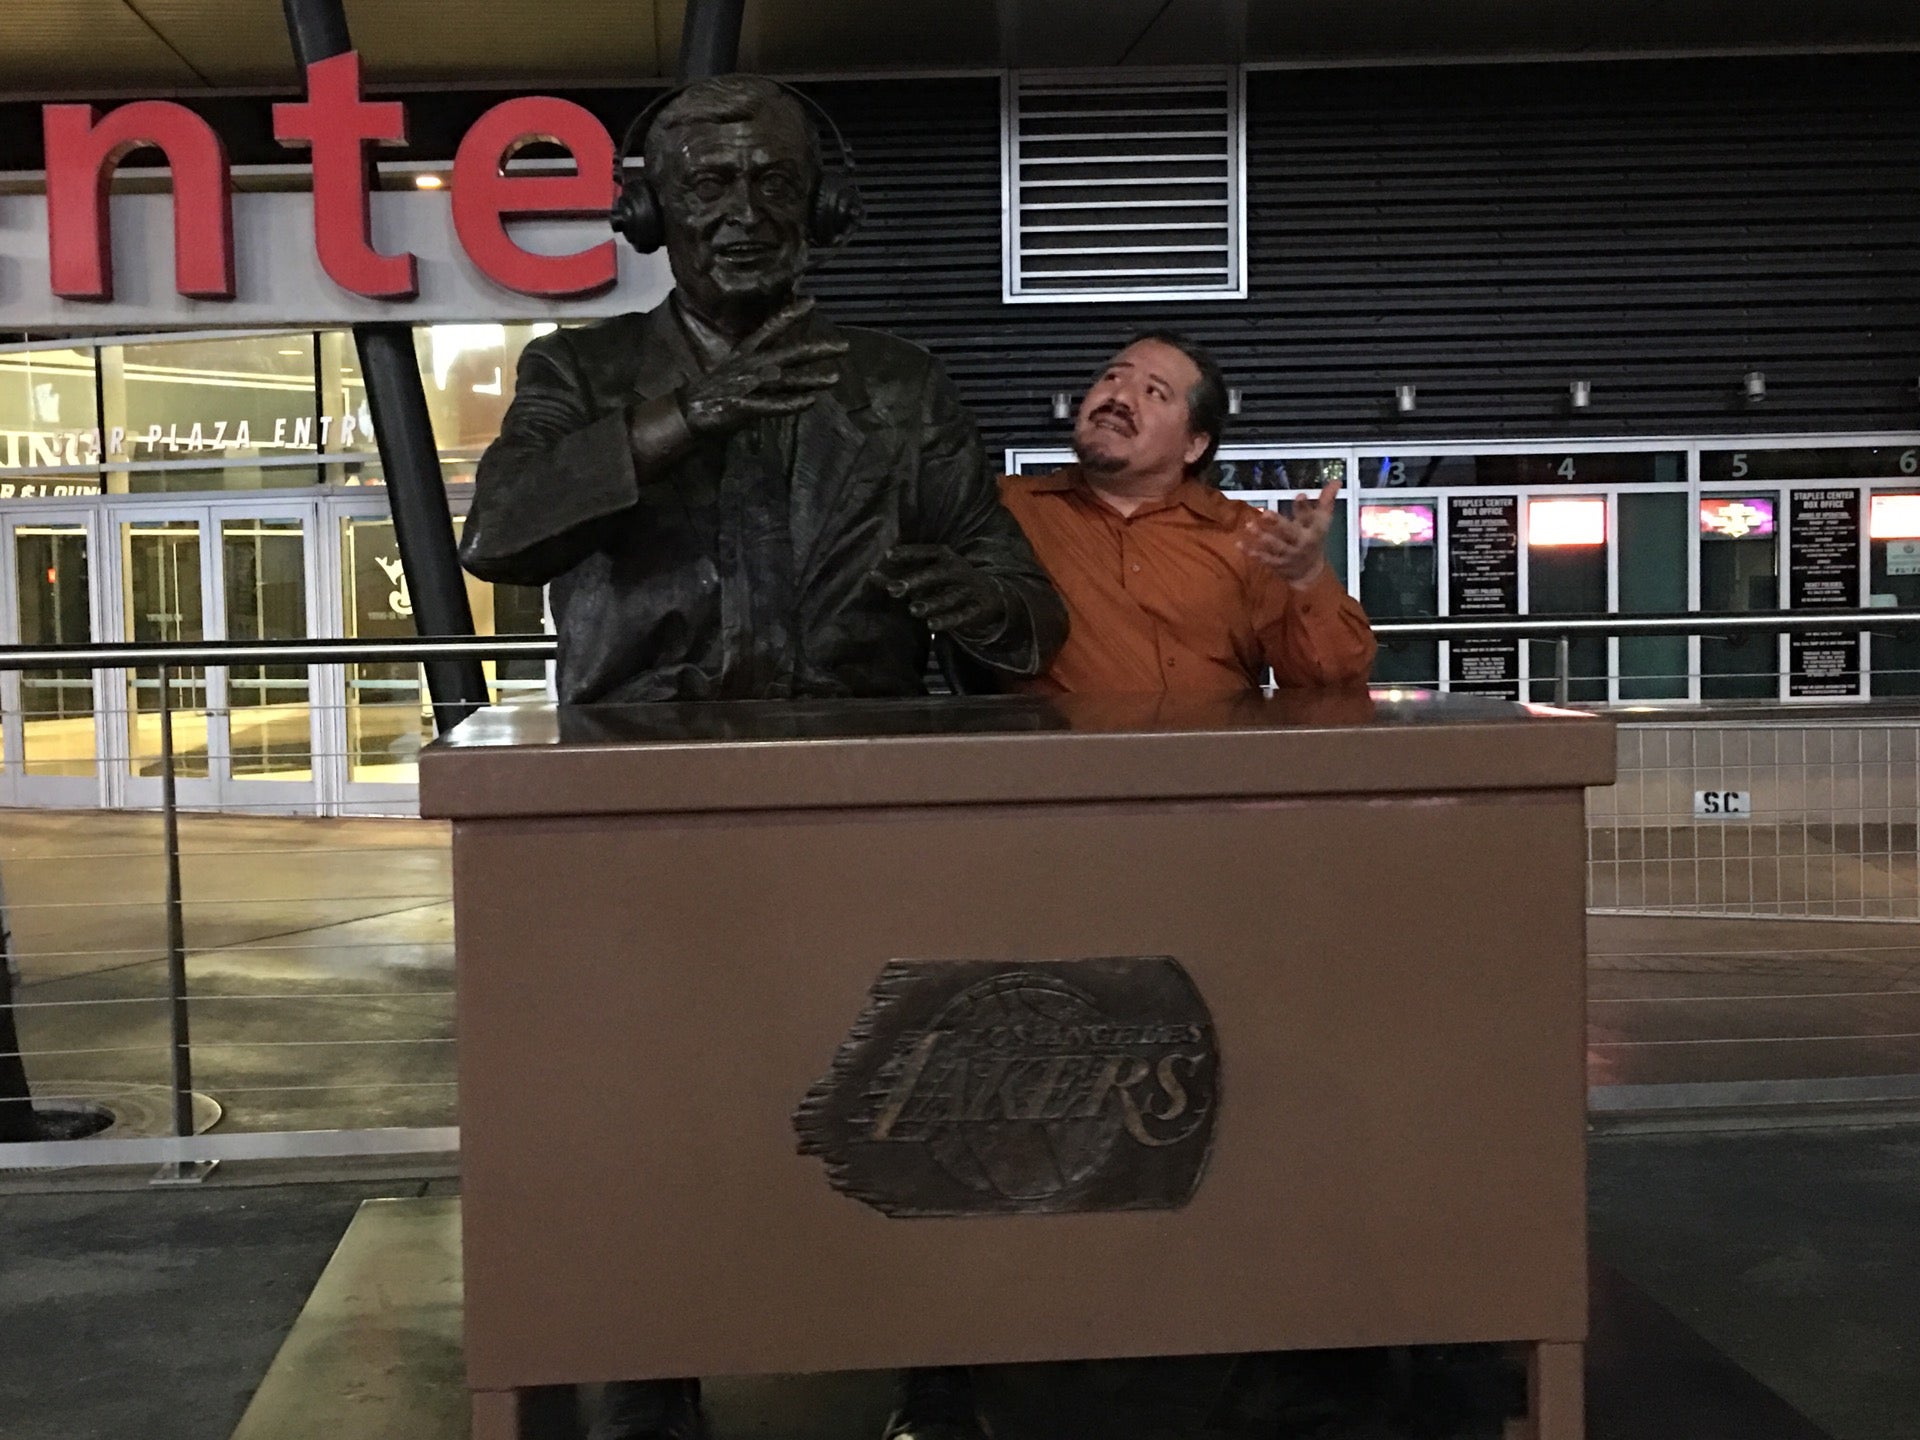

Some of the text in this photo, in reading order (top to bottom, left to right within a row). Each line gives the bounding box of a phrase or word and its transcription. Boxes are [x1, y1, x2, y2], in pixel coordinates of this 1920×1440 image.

[147, 420, 251, 453] PLAZA
[273, 415, 374, 448] ENTR
[0, 429, 100, 468] ING
[1390, 461, 1406, 485] 3
[1557, 457, 1577, 481] 4
[1732, 454, 1749, 478] 5
[1900, 449, 1918, 474] 6
[1219, 464, 1237, 487] 2
[1452, 498, 1513, 507] STAPLES CENTER
[1793, 491, 1855, 500] STAPLES CENTER
[1803, 500, 1845, 509] BOX OFFICE
[1462, 507, 1503, 516] BOX OFFICE
[1704, 791, 1739, 813] SC
[848, 1027, 1212, 1147] LAKERS
